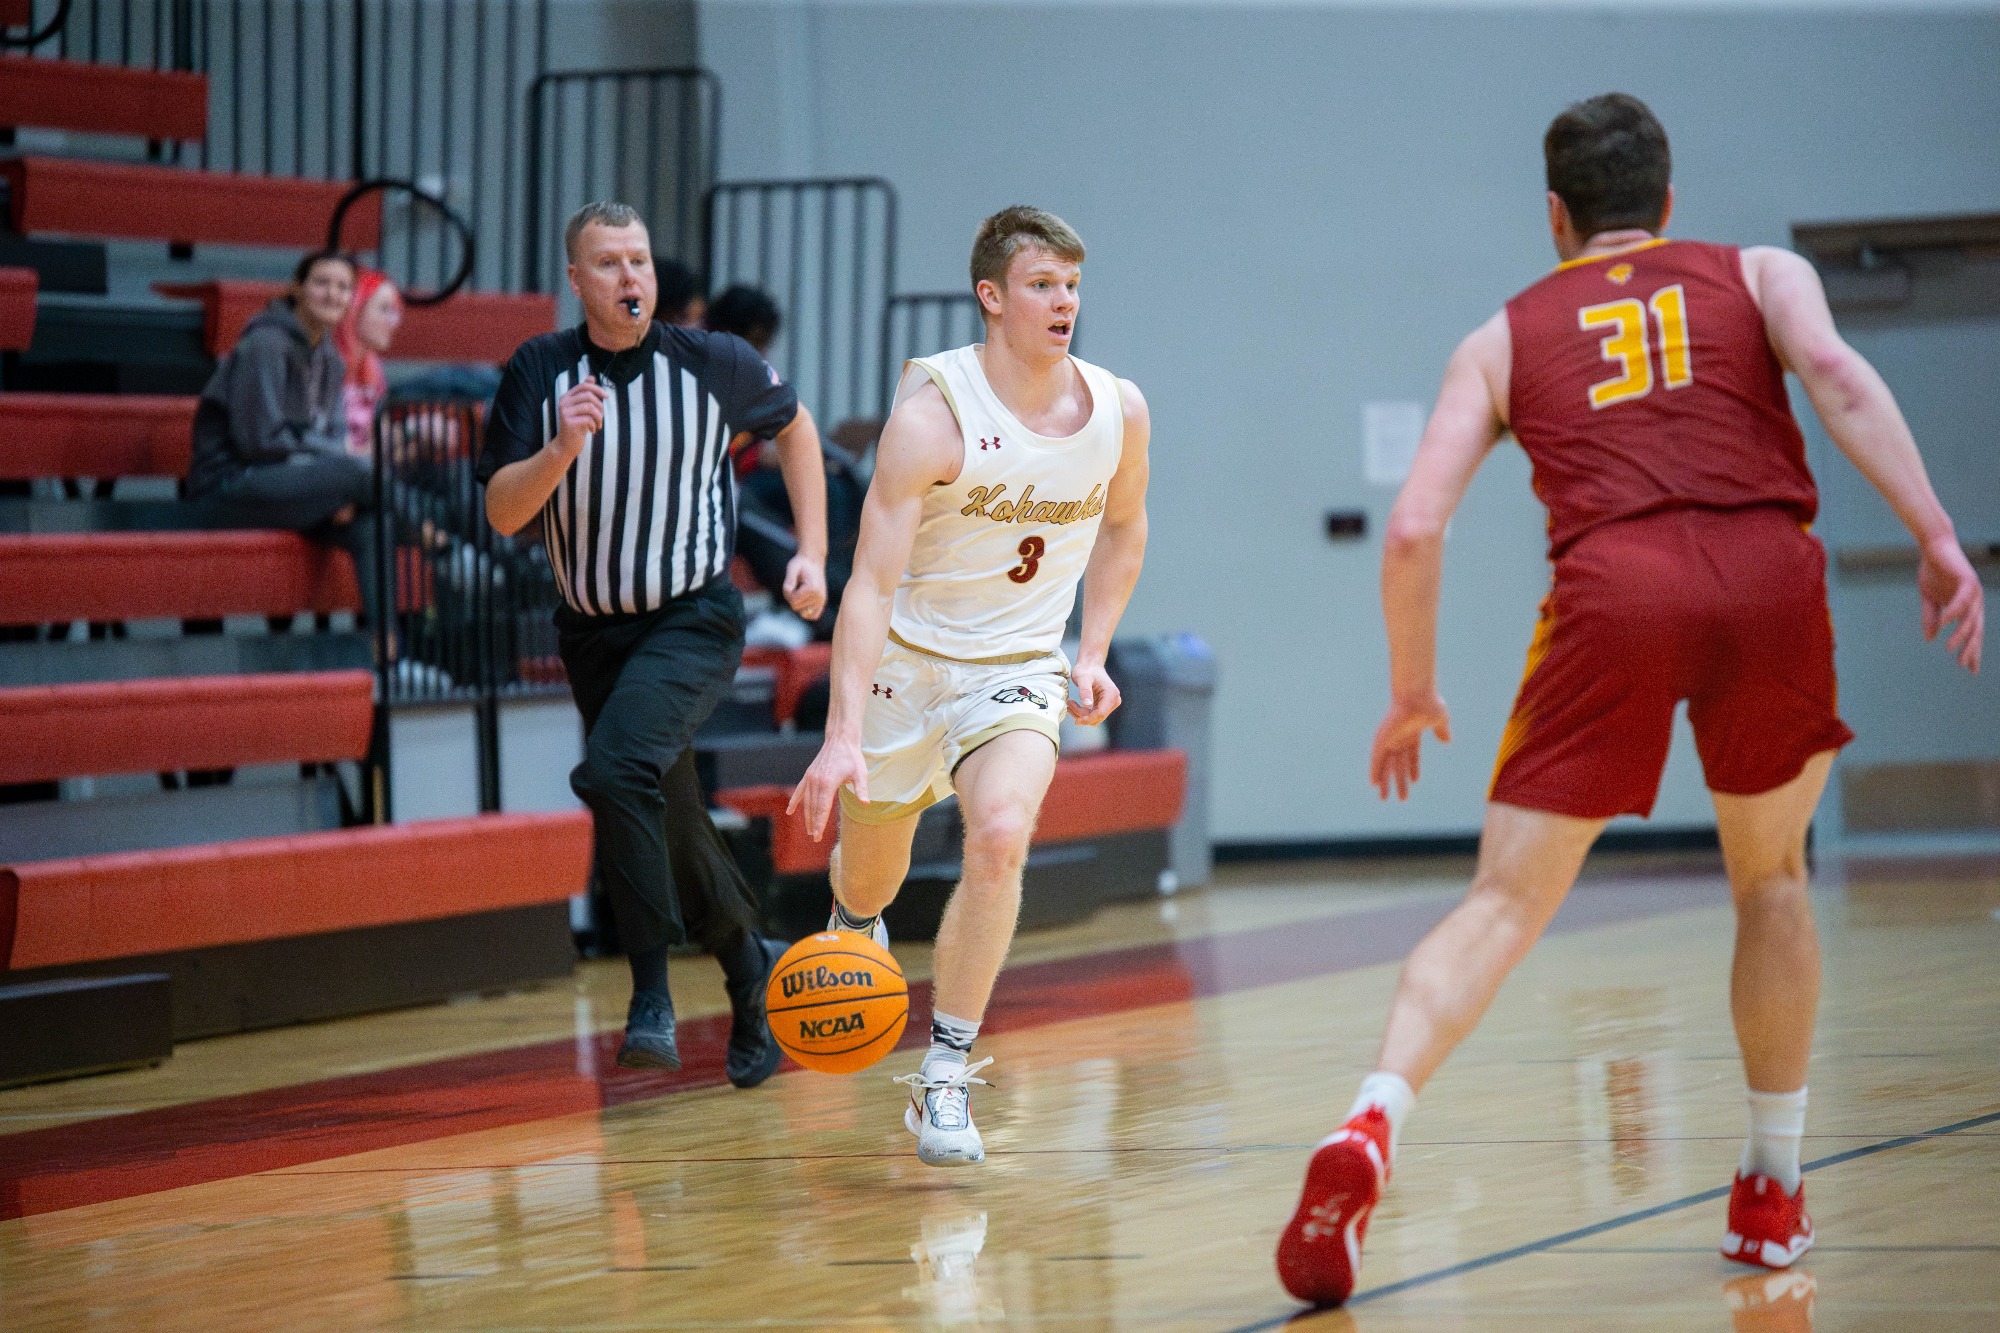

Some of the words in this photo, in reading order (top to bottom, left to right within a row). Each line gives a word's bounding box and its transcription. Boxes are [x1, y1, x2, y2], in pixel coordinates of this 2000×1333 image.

[1578, 284, 1693, 411] 31
[1007, 535, 1045, 584] 3
[781, 965, 873, 999] Wilson
[800, 1012, 865, 1039] NCAA
